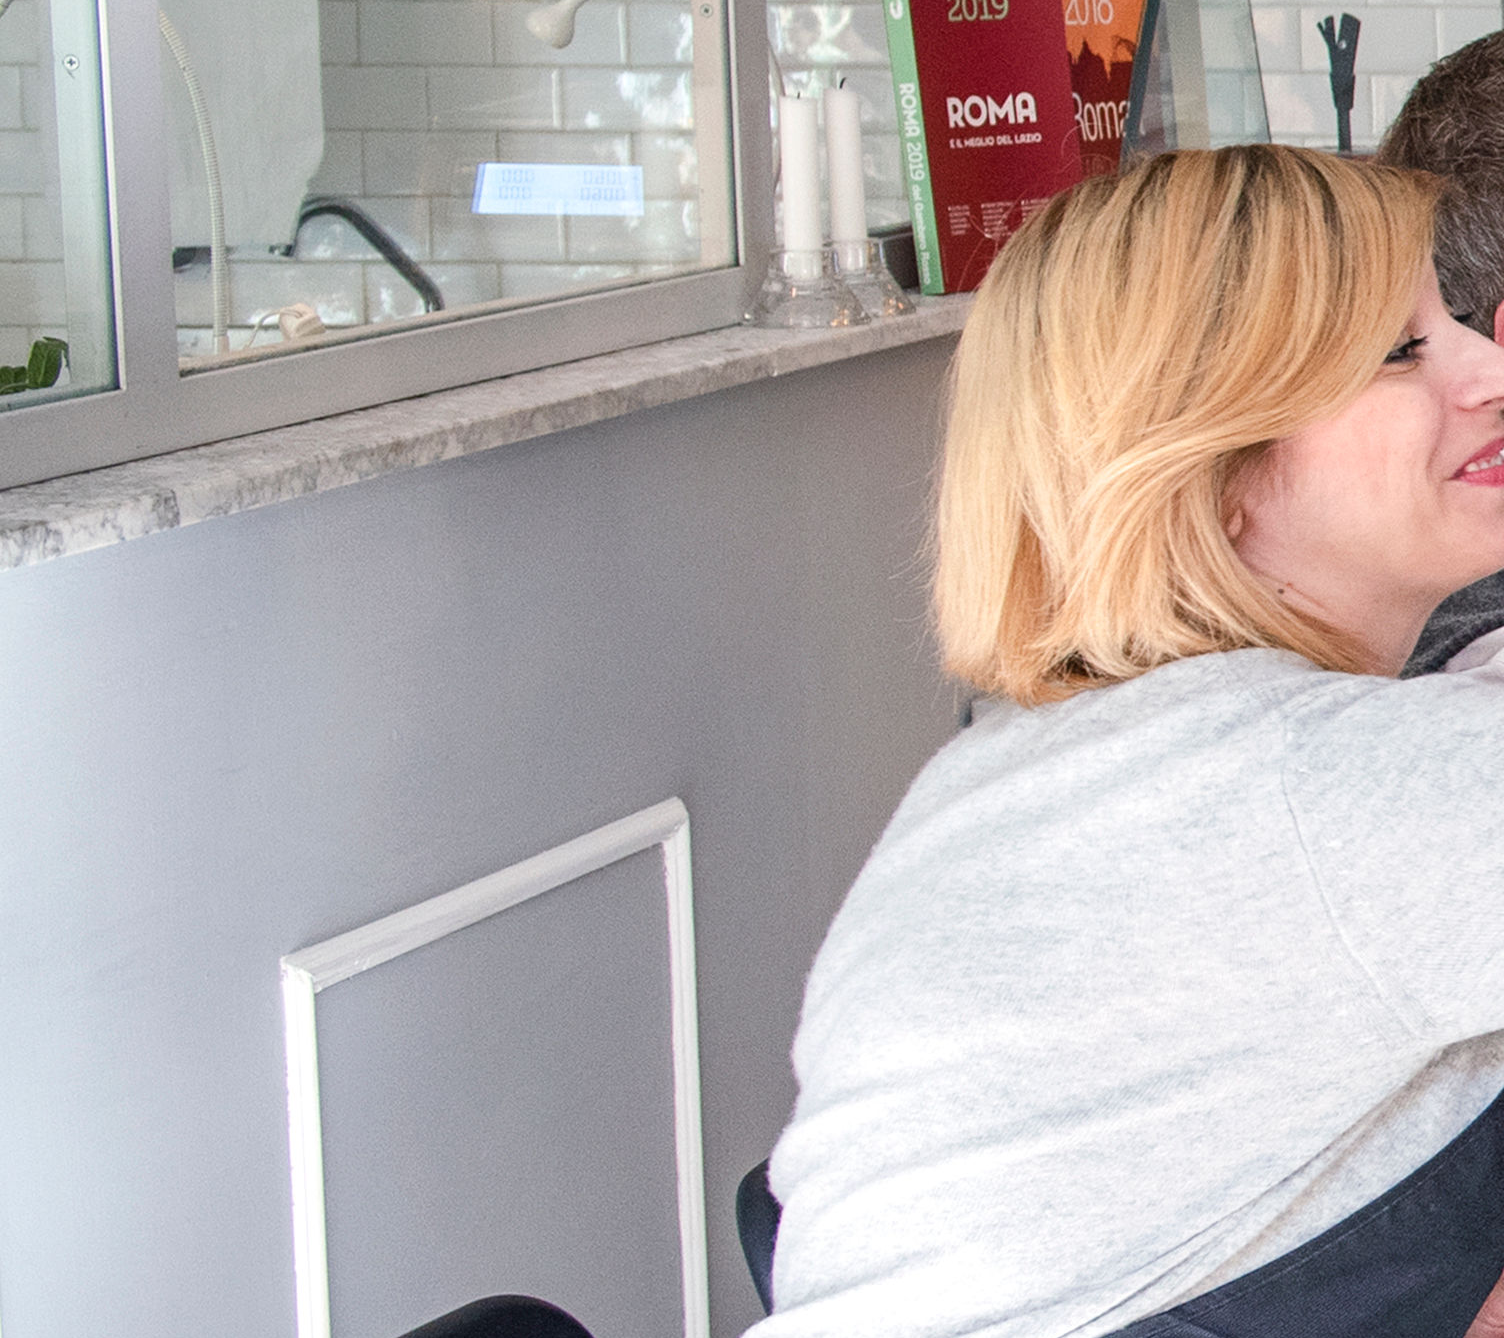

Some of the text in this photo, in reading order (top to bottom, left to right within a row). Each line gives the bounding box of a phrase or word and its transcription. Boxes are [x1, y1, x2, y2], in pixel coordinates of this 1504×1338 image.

[899, 83, 921, 137] ROMA
[946, 91, 1037, 128] ROMA
[996, 134, 1013, 145] DEL
[1014, 132, 1042, 144] LAZIO
[906, 142, 925, 180] 2019
